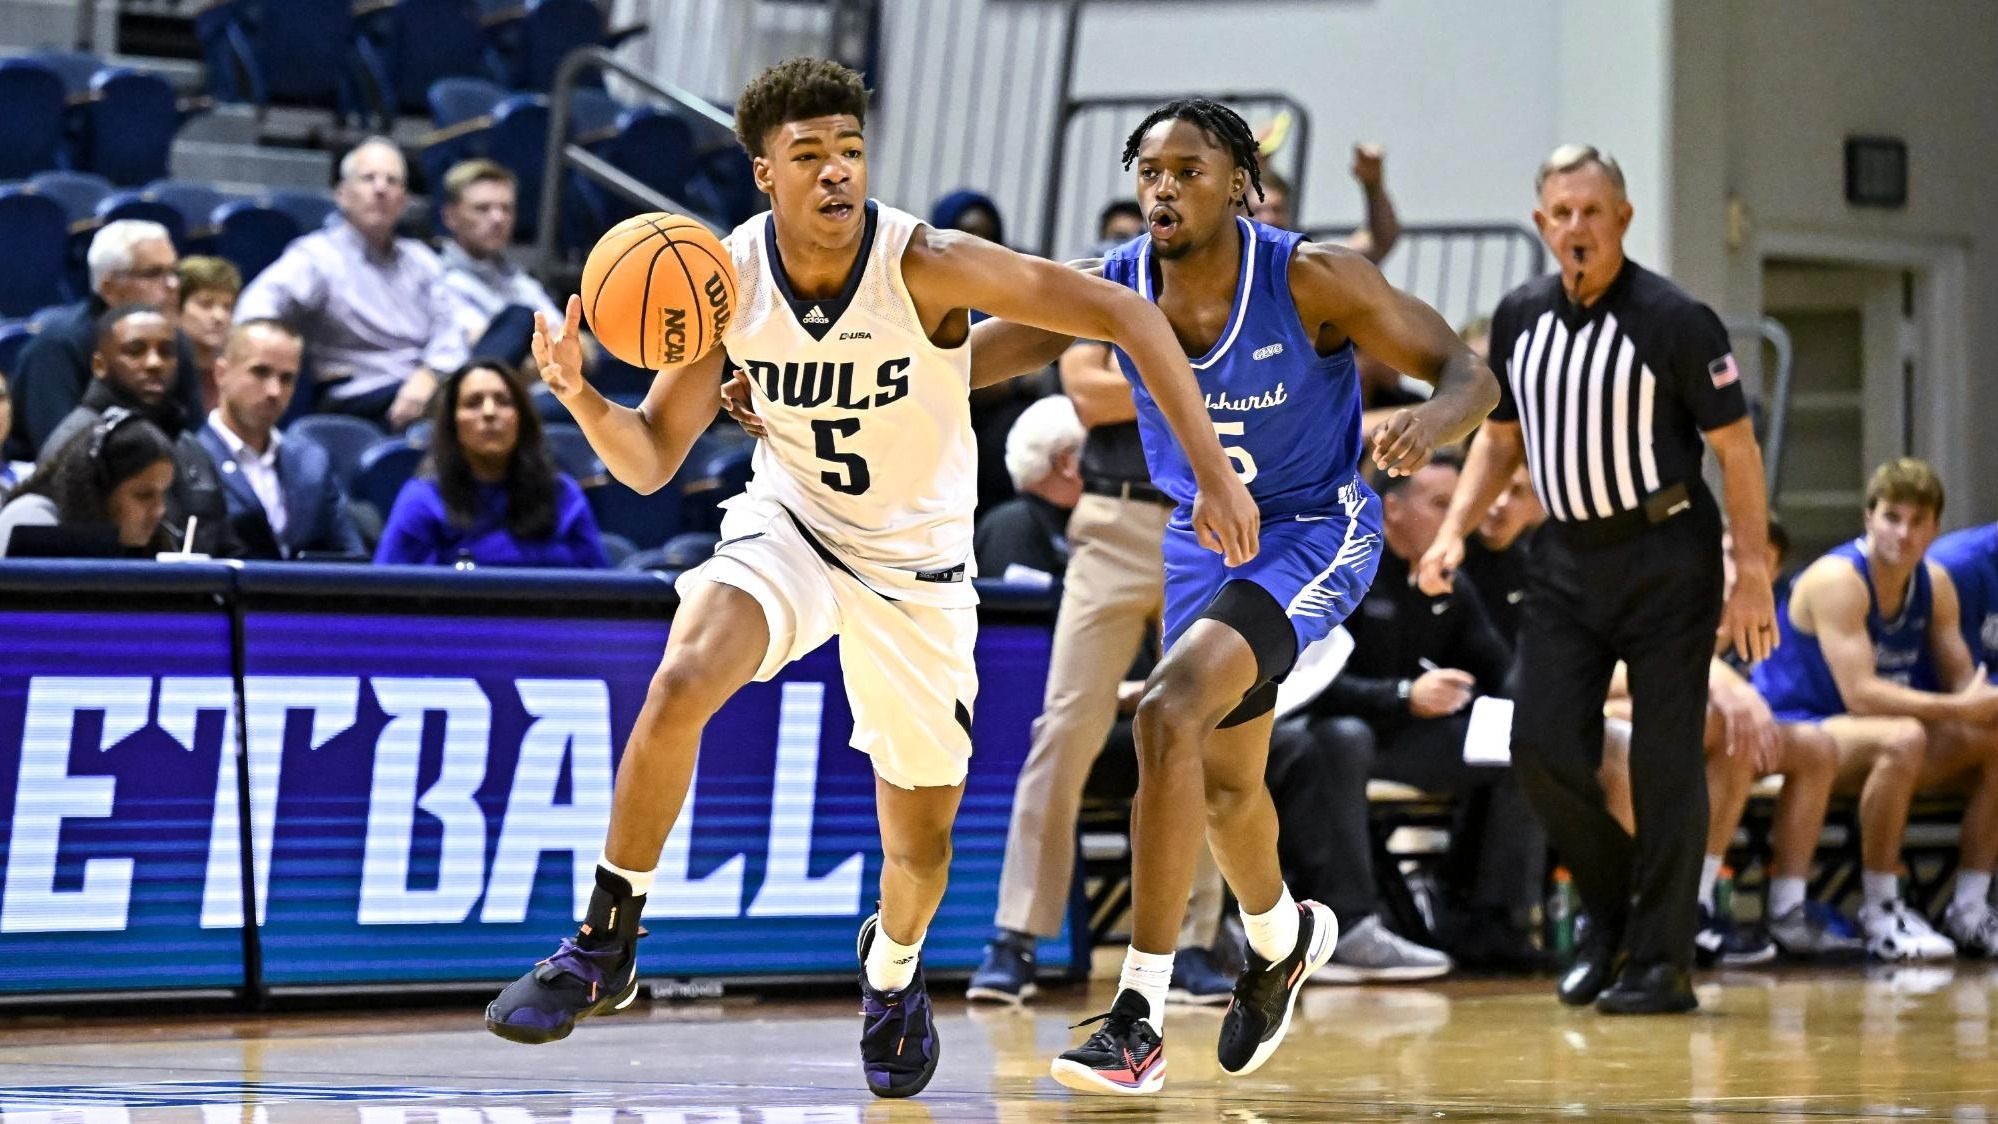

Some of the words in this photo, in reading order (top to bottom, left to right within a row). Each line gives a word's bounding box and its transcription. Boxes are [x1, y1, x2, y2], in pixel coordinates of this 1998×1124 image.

[664, 307, 686, 364] NCAA
[803, 316, 829, 324] adidas
[744, 357, 910, 409] OWLS
[811, 417, 870, 496] 5
[1212, 421, 1258, 485] 5
